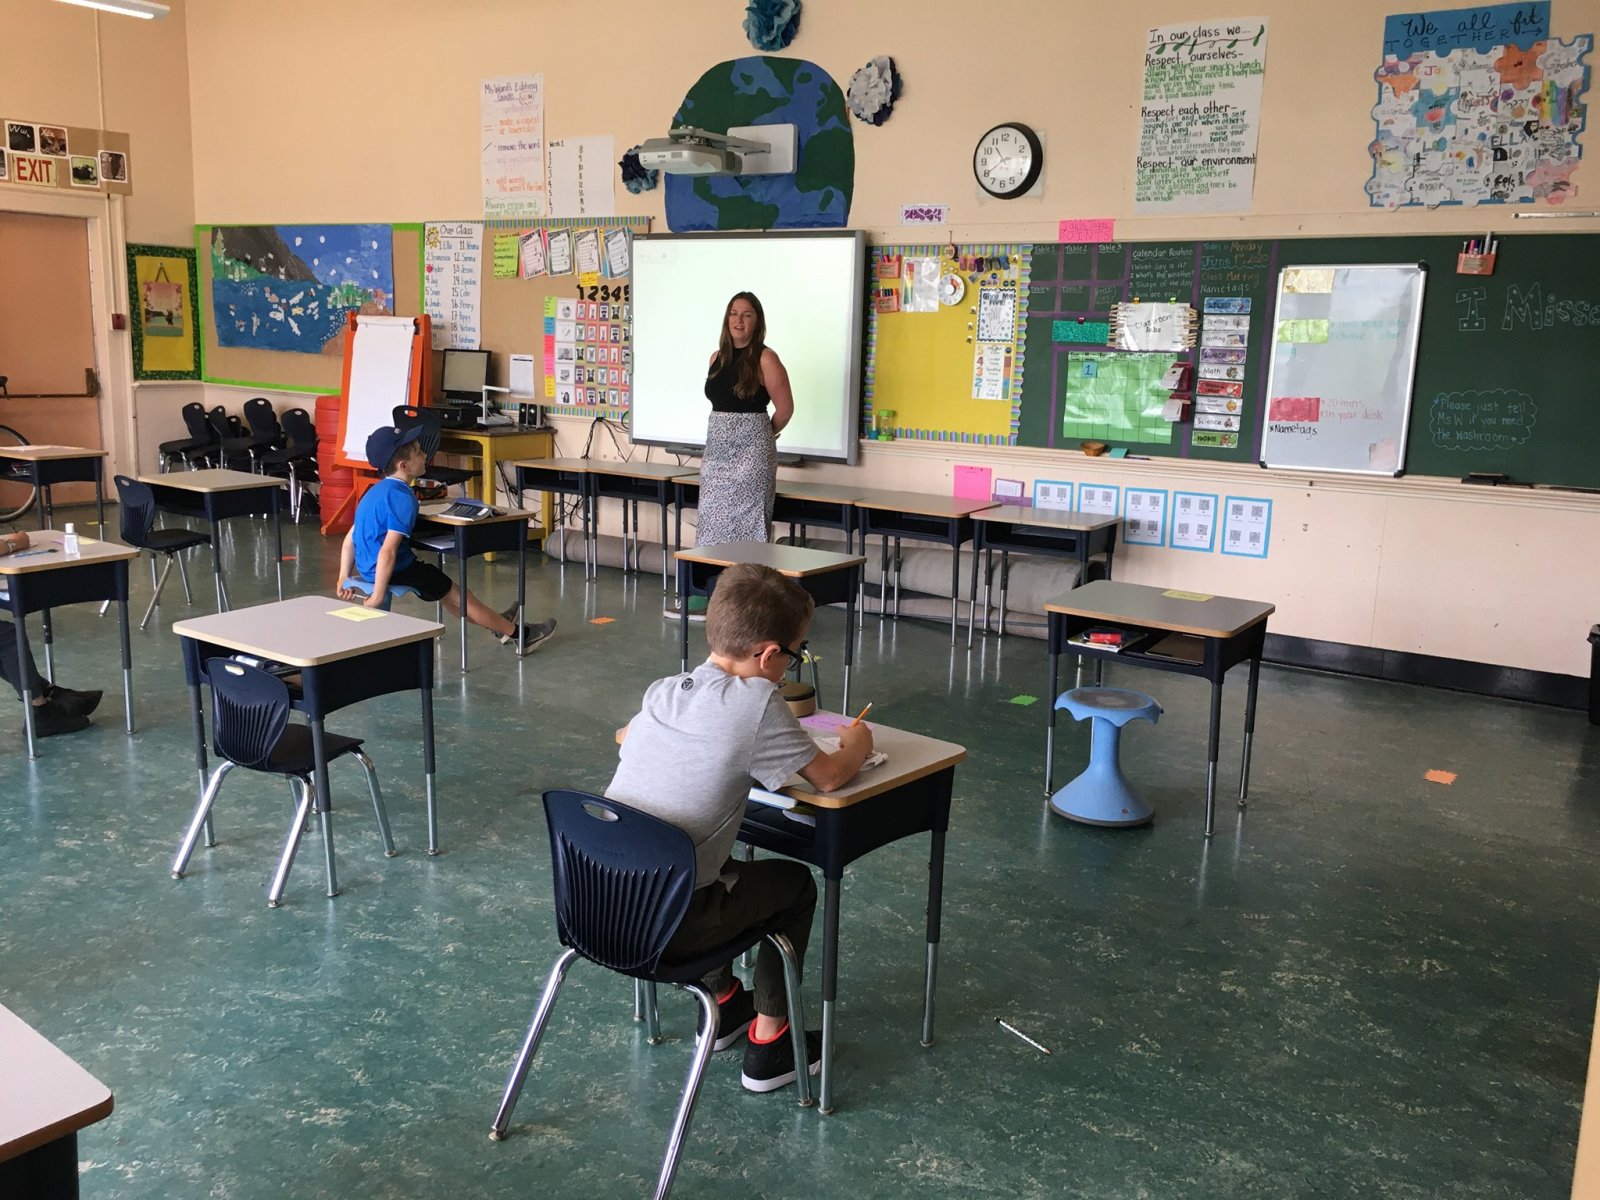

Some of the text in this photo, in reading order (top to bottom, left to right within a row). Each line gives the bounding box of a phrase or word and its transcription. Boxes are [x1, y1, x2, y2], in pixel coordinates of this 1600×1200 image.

[1402, 7, 1543, 37] We all fit
[1149, 28, 1163, 43] In
[1170, 31, 1188, 40] our
[1193, 25, 1220, 38] class
[1385, 30, 1509, 51] TOGETHER
[1145, 52, 1180, 68] Respect
[1141, 104, 1175, 120] Respect
[1178, 102, 1199, 115] each
[992, 137, 998, 146] 11
[1001, 133, 1010, 142] 12
[1014, 136, 1017, 144] 1
[984, 147, 992, 155] 10
[1018, 145, 1025, 153] 2
[981, 158, 987, 166] 9
[1021, 156, 1027, 164] 3
[1137, 153, 1257, 172] Respect our environment
[16, 157, 52, 183] EXIT
[983, 169, 990, 178] 8
[1017, 168, 1023, 176] 4
[990, 177, 996, 185] 7
[999, 180, 1006, 188] 6
[1009, 176, 1015, 185] 5
[456, 223, 473, 235] Class
[1060, 231, 1112, 242] POINTS
[1099, 244, 1116, 252] Table
[1230, 241, 1264, 255] Monday
[1202, 255, 1231, 266] June
[576, 284, 585, 300] 1
[588, 285, 599, 301] 2
[600, 285, 610, 301] 3
[611, 285, 622, 301] 4
[1456, 287, 1487, 331] I
[976, 356, 984, 366] 4
[976, 367, 983, 377] 3
[1084, 364, 1093, 376] 1
[974, 378, 983, 387] 2
[1507, 401, 1526, 414] tell
[1362, 410, 1383, 421] desk
[1481, 418, 1497, 428] you
[1502, 414, 1524, 426] need
[1437, 427, 1509, 442] the washroom
